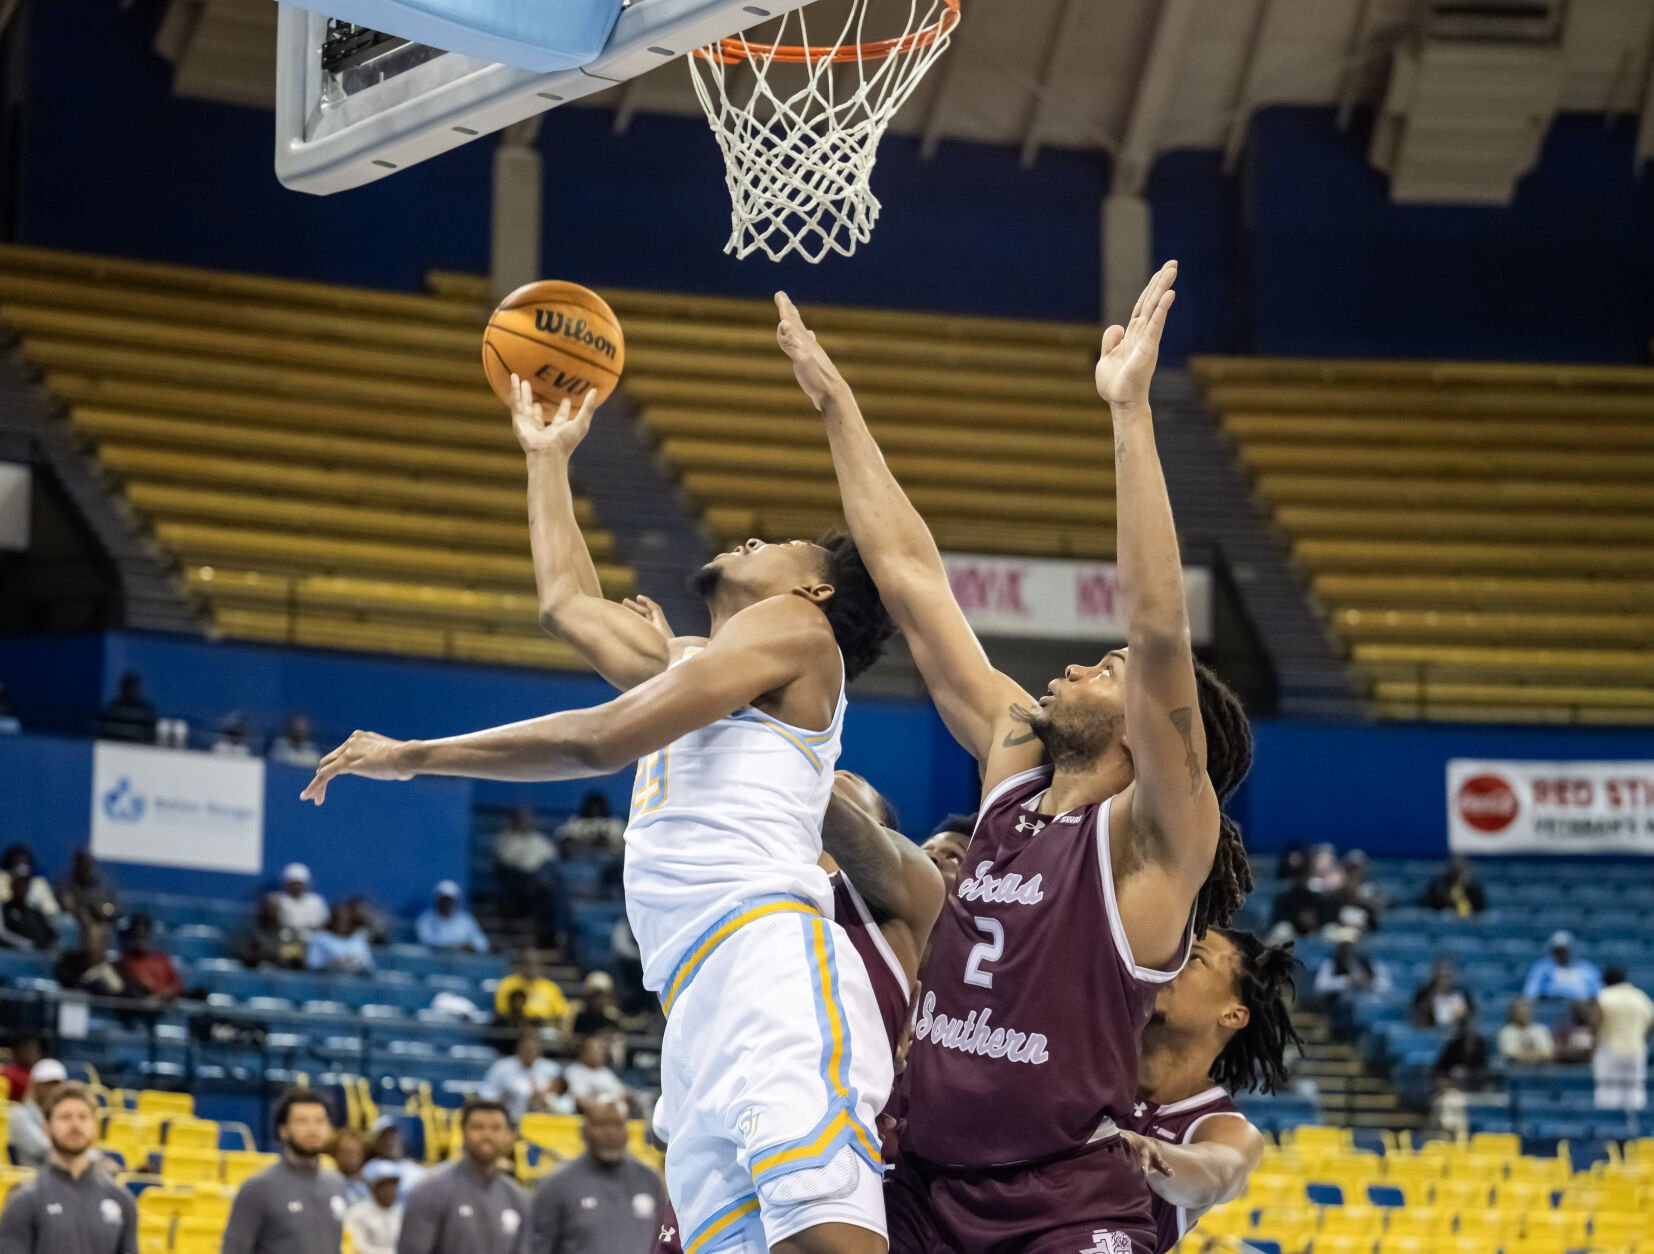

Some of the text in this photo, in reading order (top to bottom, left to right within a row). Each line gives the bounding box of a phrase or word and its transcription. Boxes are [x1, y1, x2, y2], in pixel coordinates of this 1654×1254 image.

[535, 308, 616, 360] Wilson
[534, 363, 591, 396] EVO
[1531, 779, 1594, 807] RED
[963, 916, 1005, 989] 2
[916, 990, 1049, 1065] Southern
